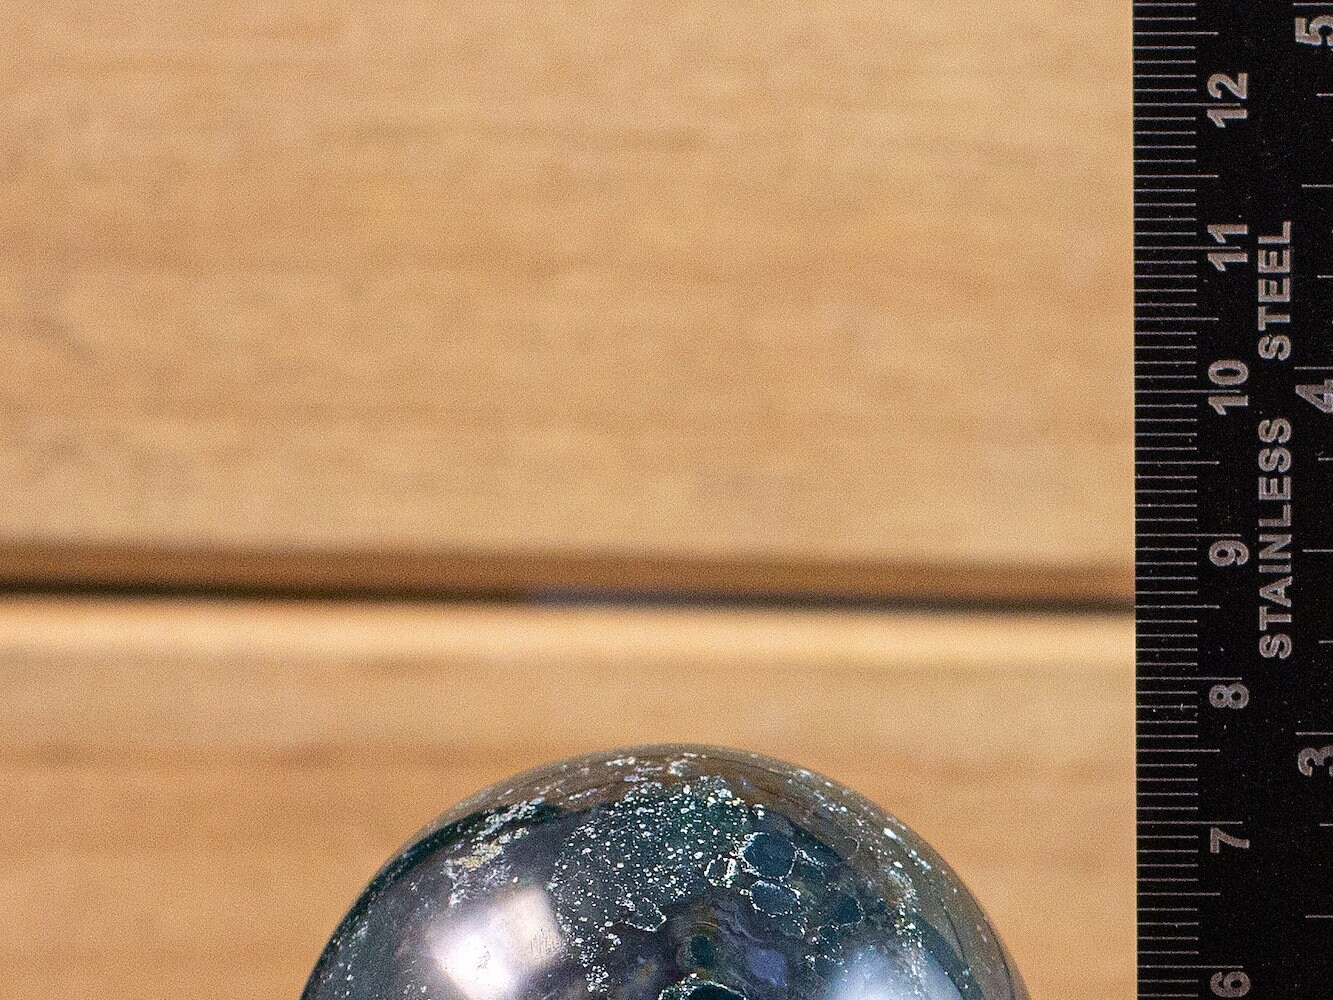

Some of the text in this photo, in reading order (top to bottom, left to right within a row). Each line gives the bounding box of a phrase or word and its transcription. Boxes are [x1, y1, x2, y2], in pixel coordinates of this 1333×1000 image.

[1207, 72, 1248, 128] 12
[1207, 223, 1248, 271] 11
[1208, 360, 1249, 416] 10
[1257, 220, 1292, 659] STAINLESS STEEL
[1208, 540, 1249, 566] 9
[1209, 684, 1249, 709] 8
[1210, 827, 1250, 854] 7
[1210, 971, 1250, 998] 6
